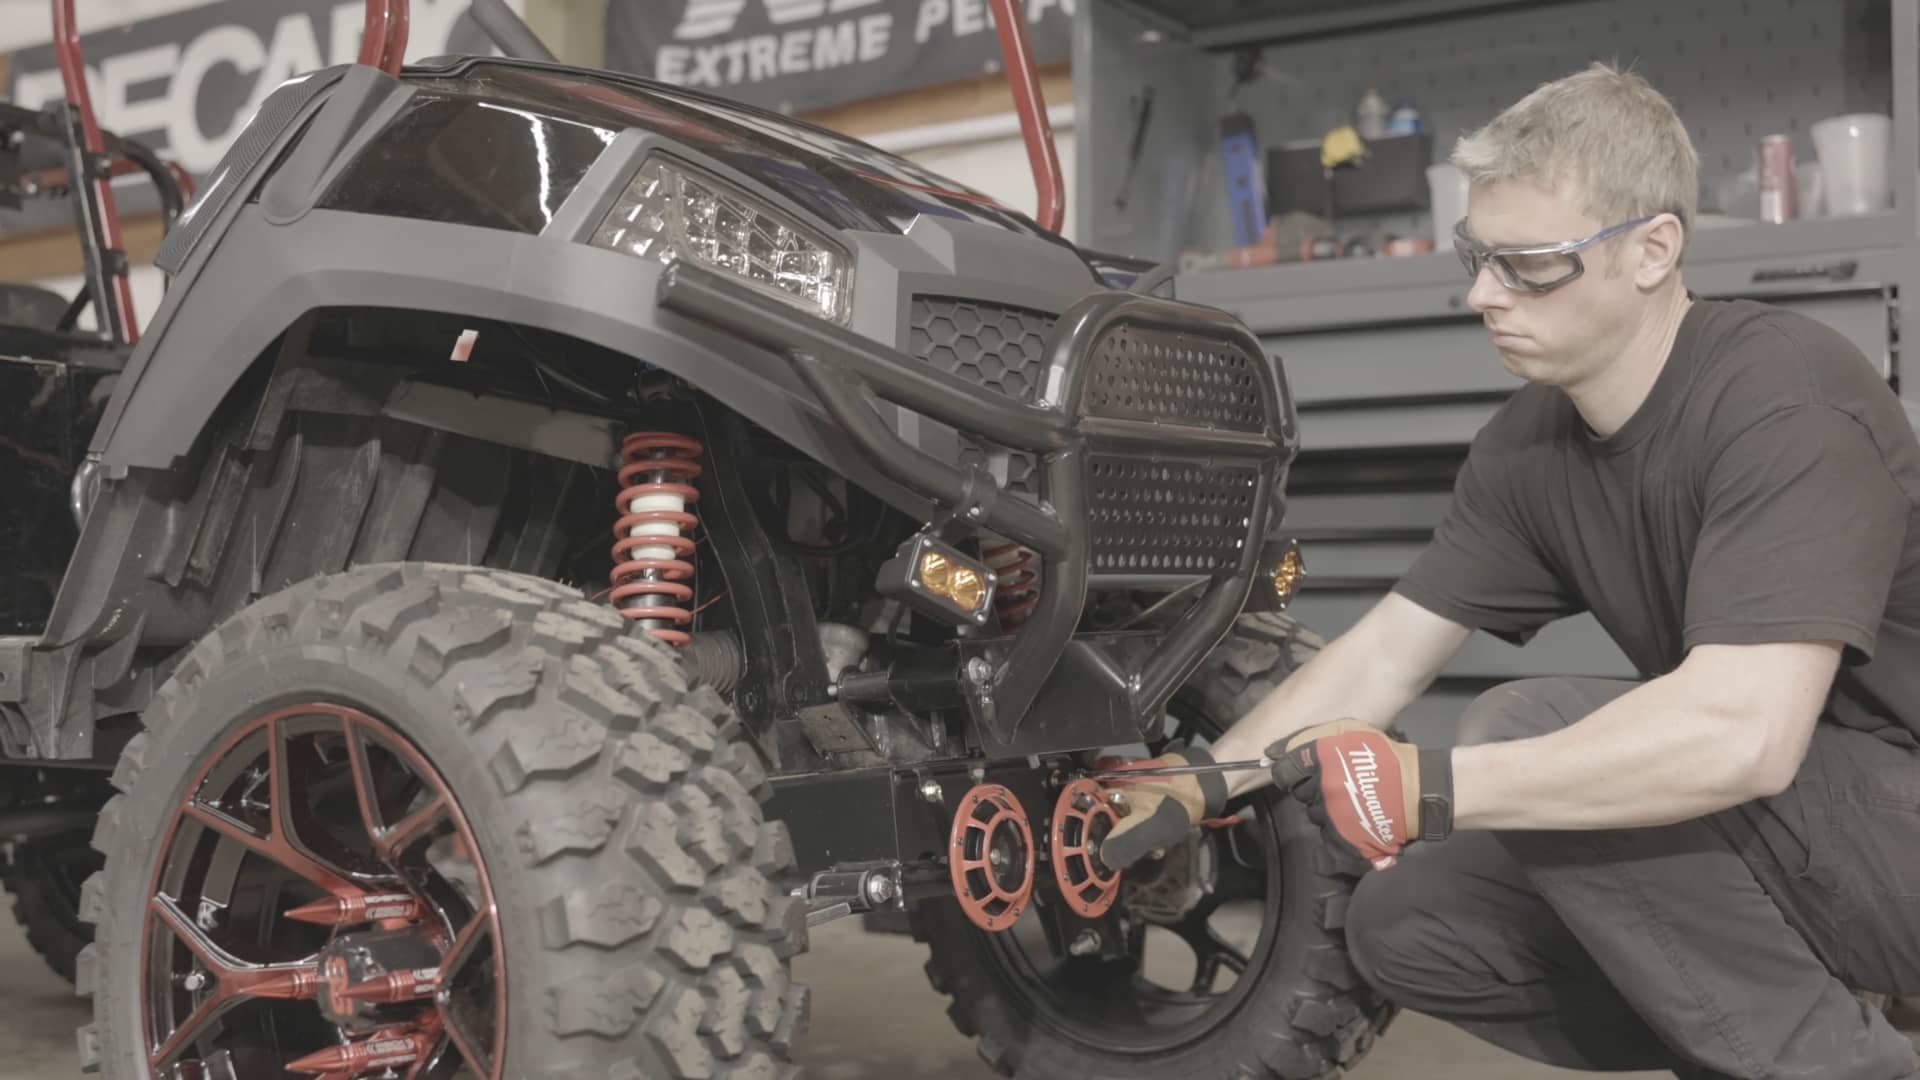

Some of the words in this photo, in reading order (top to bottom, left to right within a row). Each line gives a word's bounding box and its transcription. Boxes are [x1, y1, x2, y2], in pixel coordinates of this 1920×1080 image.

[655, 13, 893, 88] EXTREME
[915, 0, 1076, 44] PEF
[1348, 741, 1394, 842] Milwaukee
